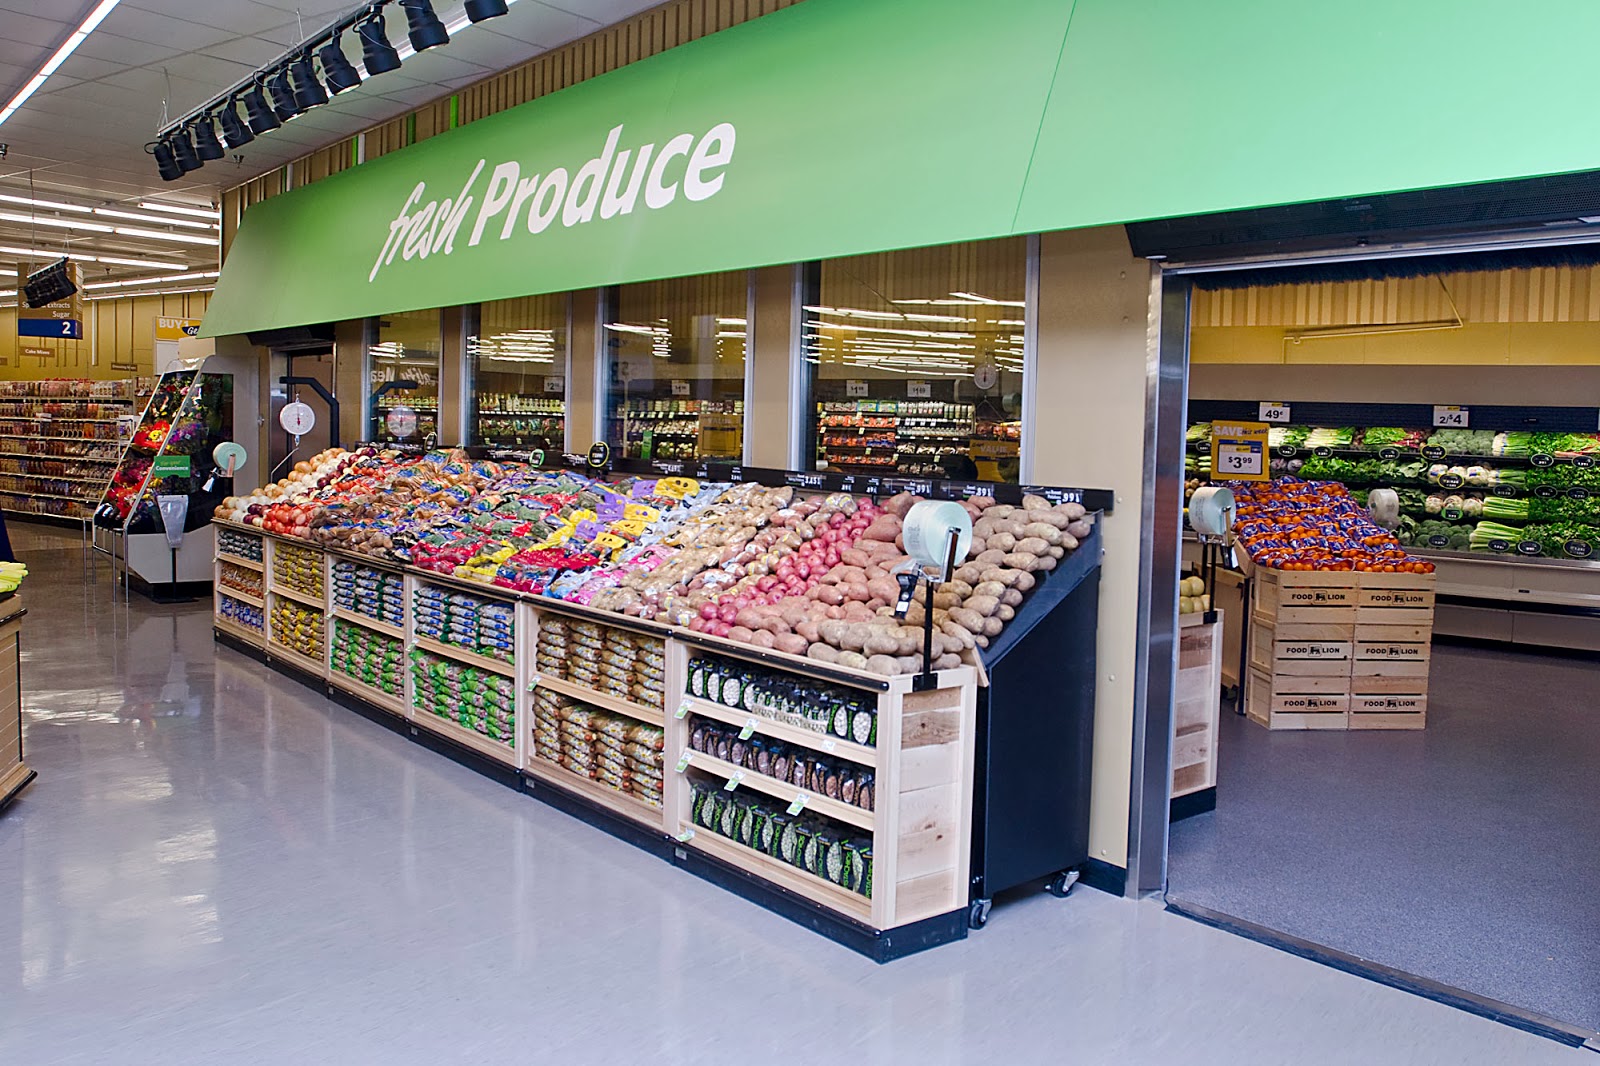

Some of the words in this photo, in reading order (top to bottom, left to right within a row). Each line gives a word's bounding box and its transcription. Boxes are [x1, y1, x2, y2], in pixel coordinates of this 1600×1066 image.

[368, 158, 486, 283] fresh
[467, 122, 736, 247] Produce
[52, 310, 70, 318] Sugar
[62, 321, 71, 334] 2
[159, 318, 182, 328] BUY
[1214, 426, 1242, 436] SAVE
[843, 851, 853, 889] ISTACHIOS
